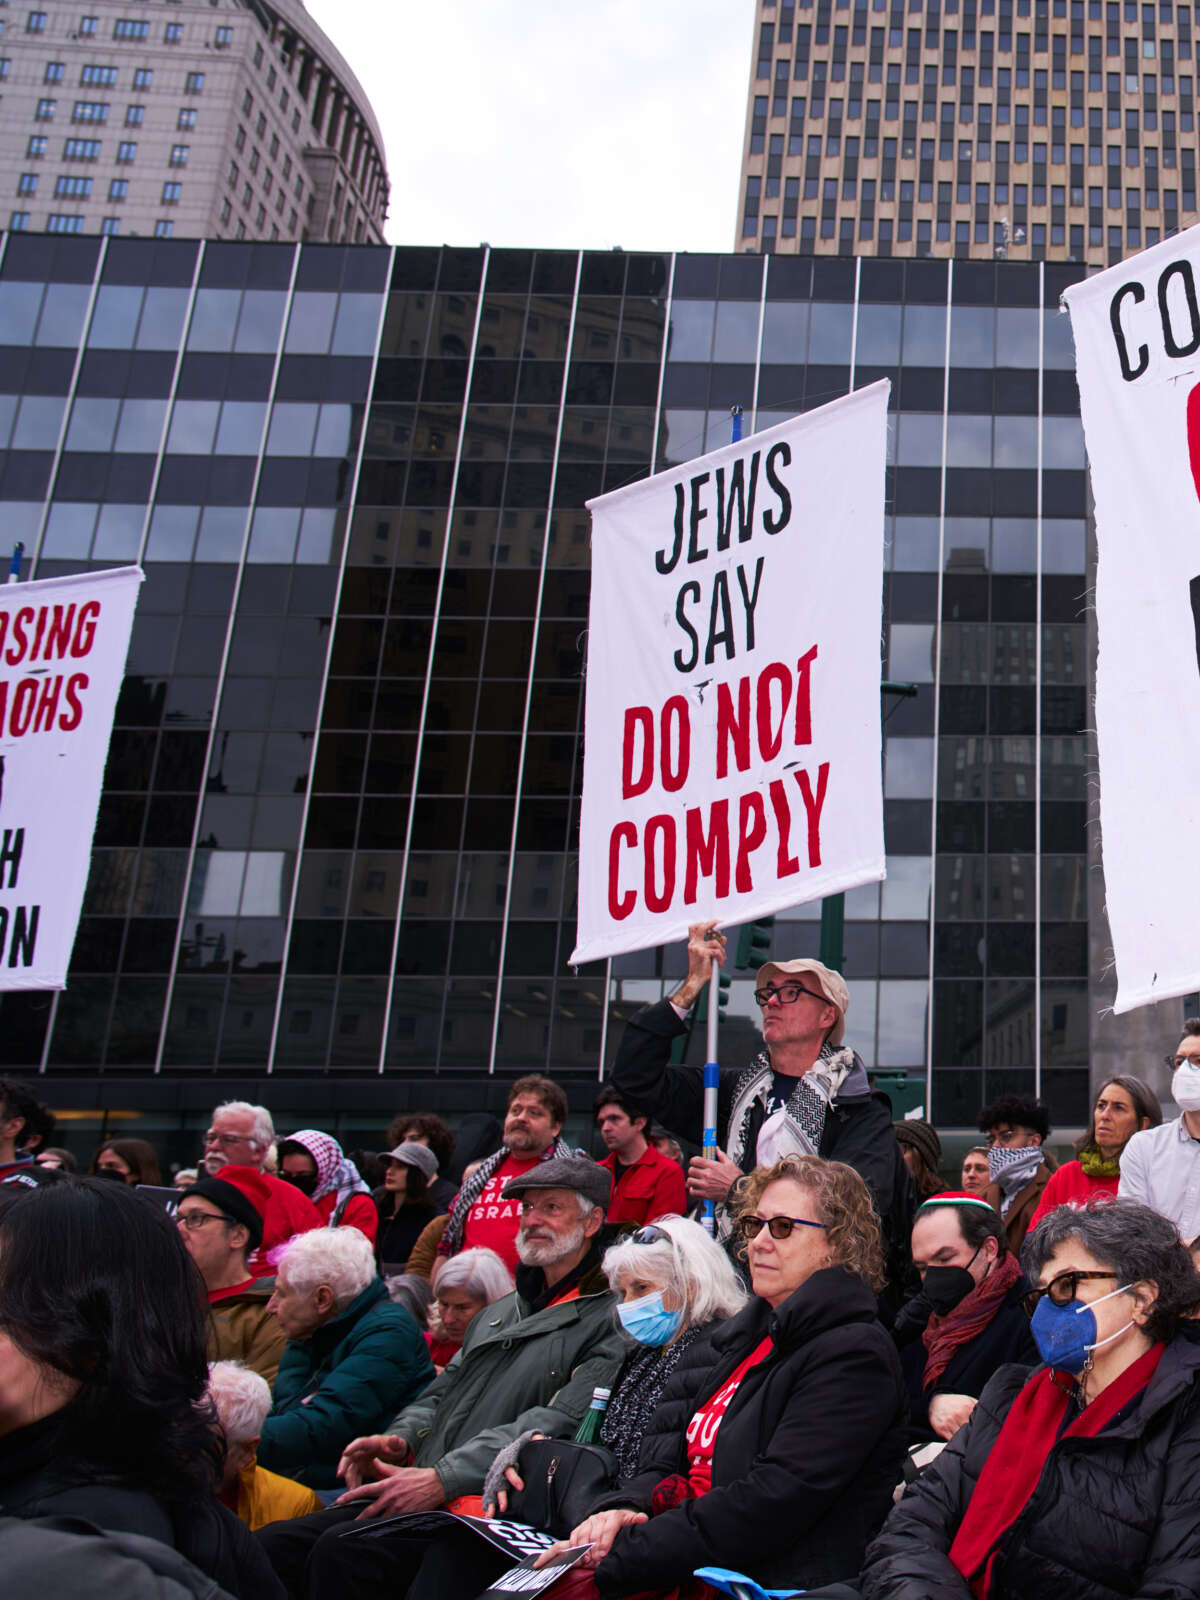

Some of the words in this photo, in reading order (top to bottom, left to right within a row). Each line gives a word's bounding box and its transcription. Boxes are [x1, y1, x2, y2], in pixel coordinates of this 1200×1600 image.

[655, 441, 792, 575] JEWS
[674, 556, 765, 673] SAY
[622, 694, 691, 801] DO
[716, 643, 819, 780] NOT
[607, 761, 831, 921] COMPLY
[0, 905, 40, 969] N
[467, 1202, 524, 1223] ISRAE
